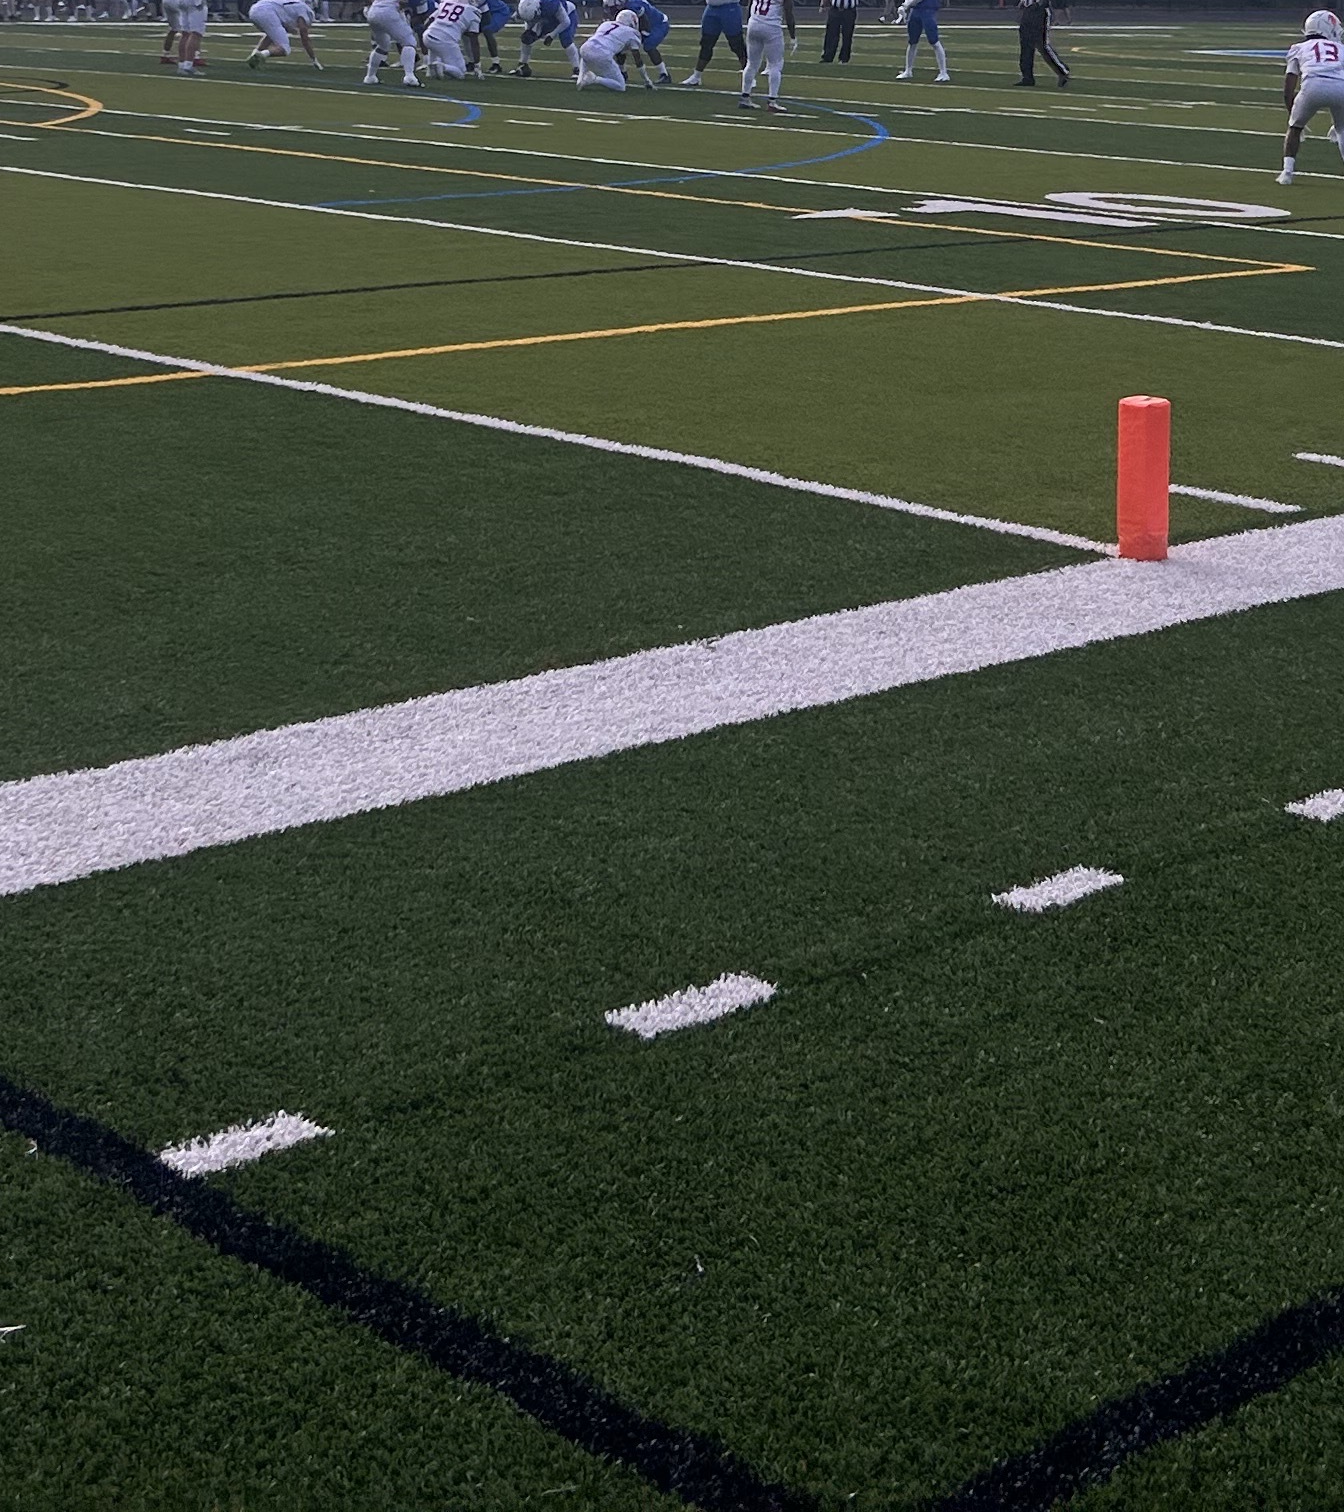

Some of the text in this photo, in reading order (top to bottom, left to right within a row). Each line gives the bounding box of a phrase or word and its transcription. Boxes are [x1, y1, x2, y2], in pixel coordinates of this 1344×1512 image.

[437, 3, 465, 23] 58
[603, 23, 620, 36] 7
[1311, 42, 1339, 63] 13
[899, 191, 1293, 228] 10
